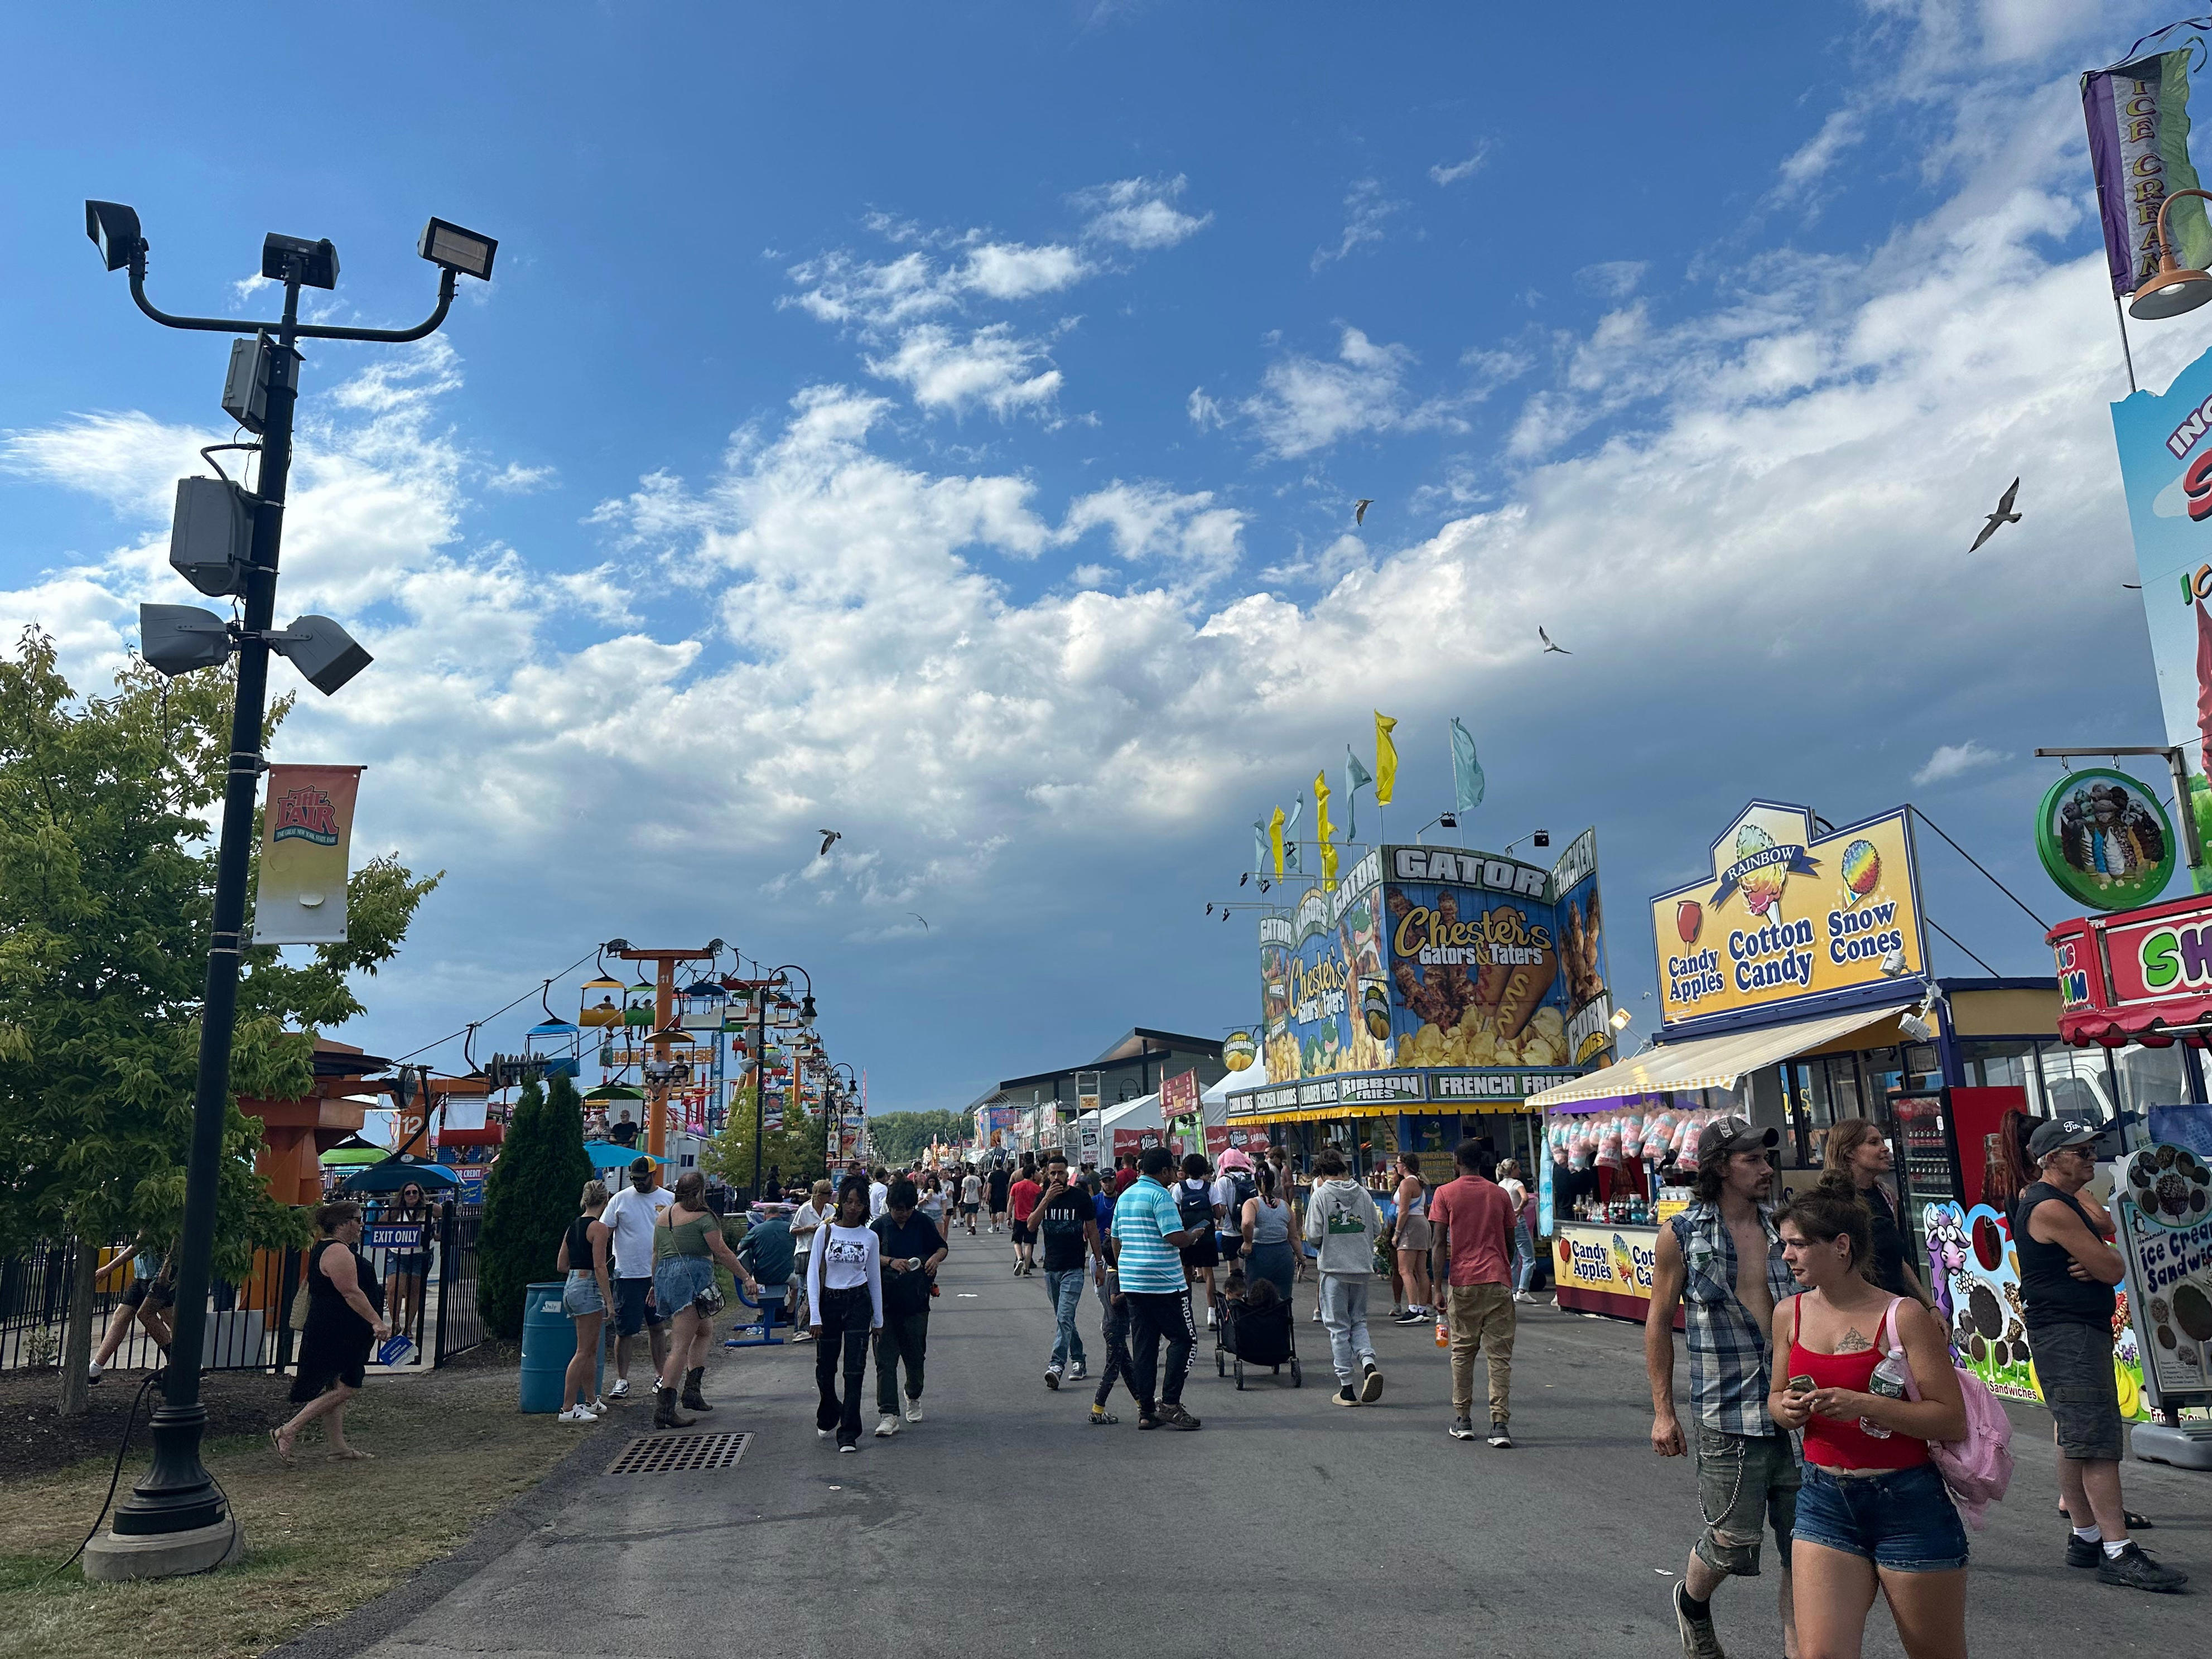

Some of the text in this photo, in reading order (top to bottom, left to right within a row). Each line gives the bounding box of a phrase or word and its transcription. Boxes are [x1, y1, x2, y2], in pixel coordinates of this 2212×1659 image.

[2126, 80, 2157, 143] ICE
[290, 787, 328, 806] THE
[277, 799, 338, 834] FAIR
[1395, 849, 1546, 898] GATOR
[1553, 830, 1594, 902] CHICKEN
[1727, 846, 1796, 881] RAINBOW
[1333, 851, 1380, 922] GATOR
[1260, 918, 1293, 945] GATOR
[1394, 906, 1552, 957] Chester's
[1829, 902, 1895, 937] Snow
[1729, 918, 1813, 960] Cotton
[1830, 930, 1902, 963] Cones
[1419, 943, 1476, 964] Gators
[1488, 943, 1543, 965] Taters
[1669, 948, 1719, 977] Candy
[2055, 944, 2075, 969] US
[1289, 943, 1347, 1018] Chester's
[1735, 951, 1812, 991] Candy
[1669, 972, 1723, 1002] Apples
[2061, 971, 2088, 1003] AM
[1298, 996, 1318, 1025] Gators
[1321, 989, 1345, 1017] Taters
[1567, 995, 1611, 1067] CORN
[1224, 1041, 1255, 1053] LEMONADE
[1577, 1032, 1604, 1065] DOGS
[1257, 1087, 1297, 1110] CHICKEN KABOBS
[1300, 1081, 1337, 1104] LOADED FRIES
[1342, 1076, 1419, 1099] RIBBON
[1356, 1088, 1395, 1100] FRIES
[1439, 1076, 1516, 1095] FRENCH
[1229, 1094, 1253, 1112] CORN DOGS
[402, 1116, 422, 1134] 12
[1230, 1134, 1248, 1145] Utica
[464, 1169, 481, 1178] CREDIT
[373, 1231, 418, 1243] EXIT ONLY
[2137, 1227, 2167, 1246] Homemade
[1572, 1240, 1607, 1265] Candy
[1633, 1245, 1655, 1266] Cot
[1573, 1258, 1612, 1281] Apples
[1637, 1266, 1652, 1286] Ca
[1181, 1296, 1198, 1373] PROJECT ROCK
[1989, 1380, 2037, 1400] Sandwiches
